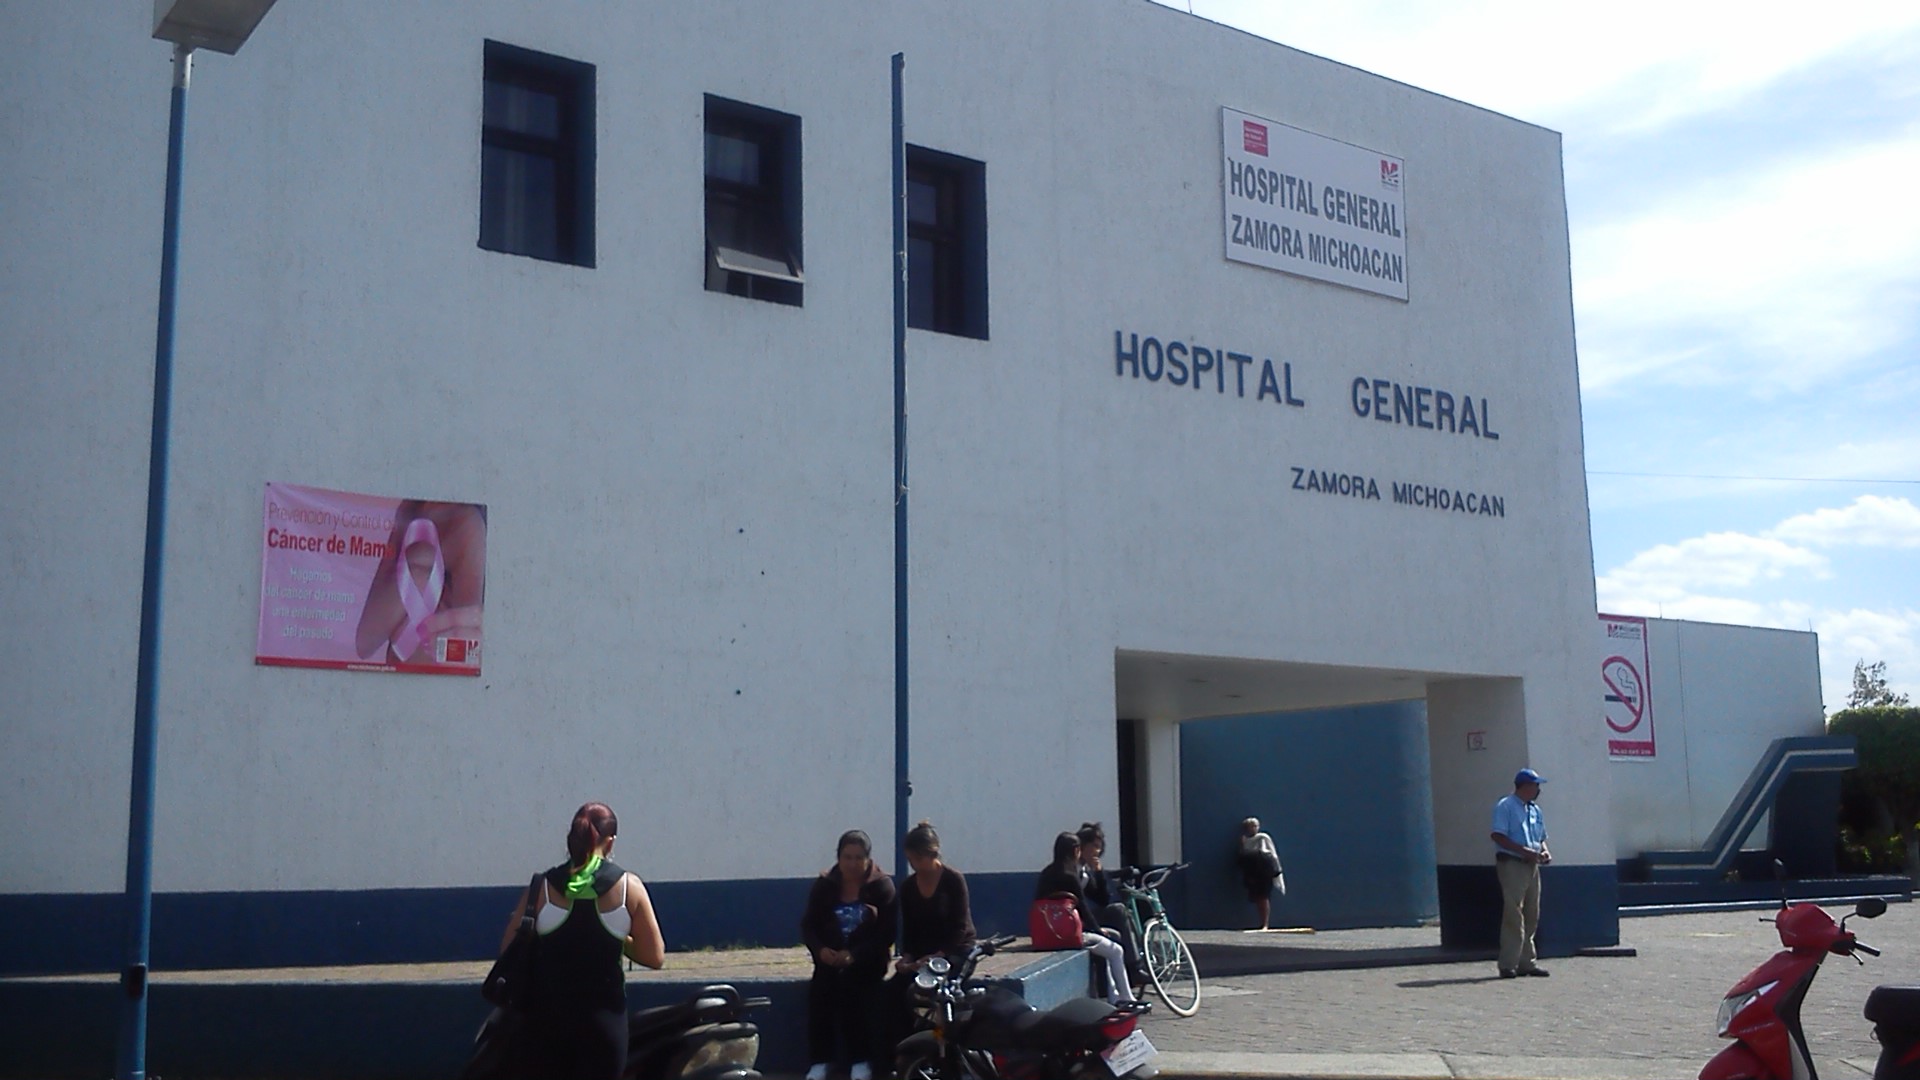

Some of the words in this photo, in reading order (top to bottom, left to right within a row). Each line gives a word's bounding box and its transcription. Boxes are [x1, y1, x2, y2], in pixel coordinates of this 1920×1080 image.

[1230, 160, 1318, 217] HOSPITAL
[1323, 186, 1401, 238] GENERAL
[1231, 214, 1304, 260] ZAMORA
[1308, 233, 1402, 283] MICHOACAN
[1115, 330, 1305, 408] HOSPITAL
[1352, 376, 1499, 440] GENERAL
[1290, 466, 1381, 500] ZAMORA
[1392, 481, 1505, 518] MICHOACAN
[267, 527, 323, 553] Cáncer
[326, 534, 346, 555] de
